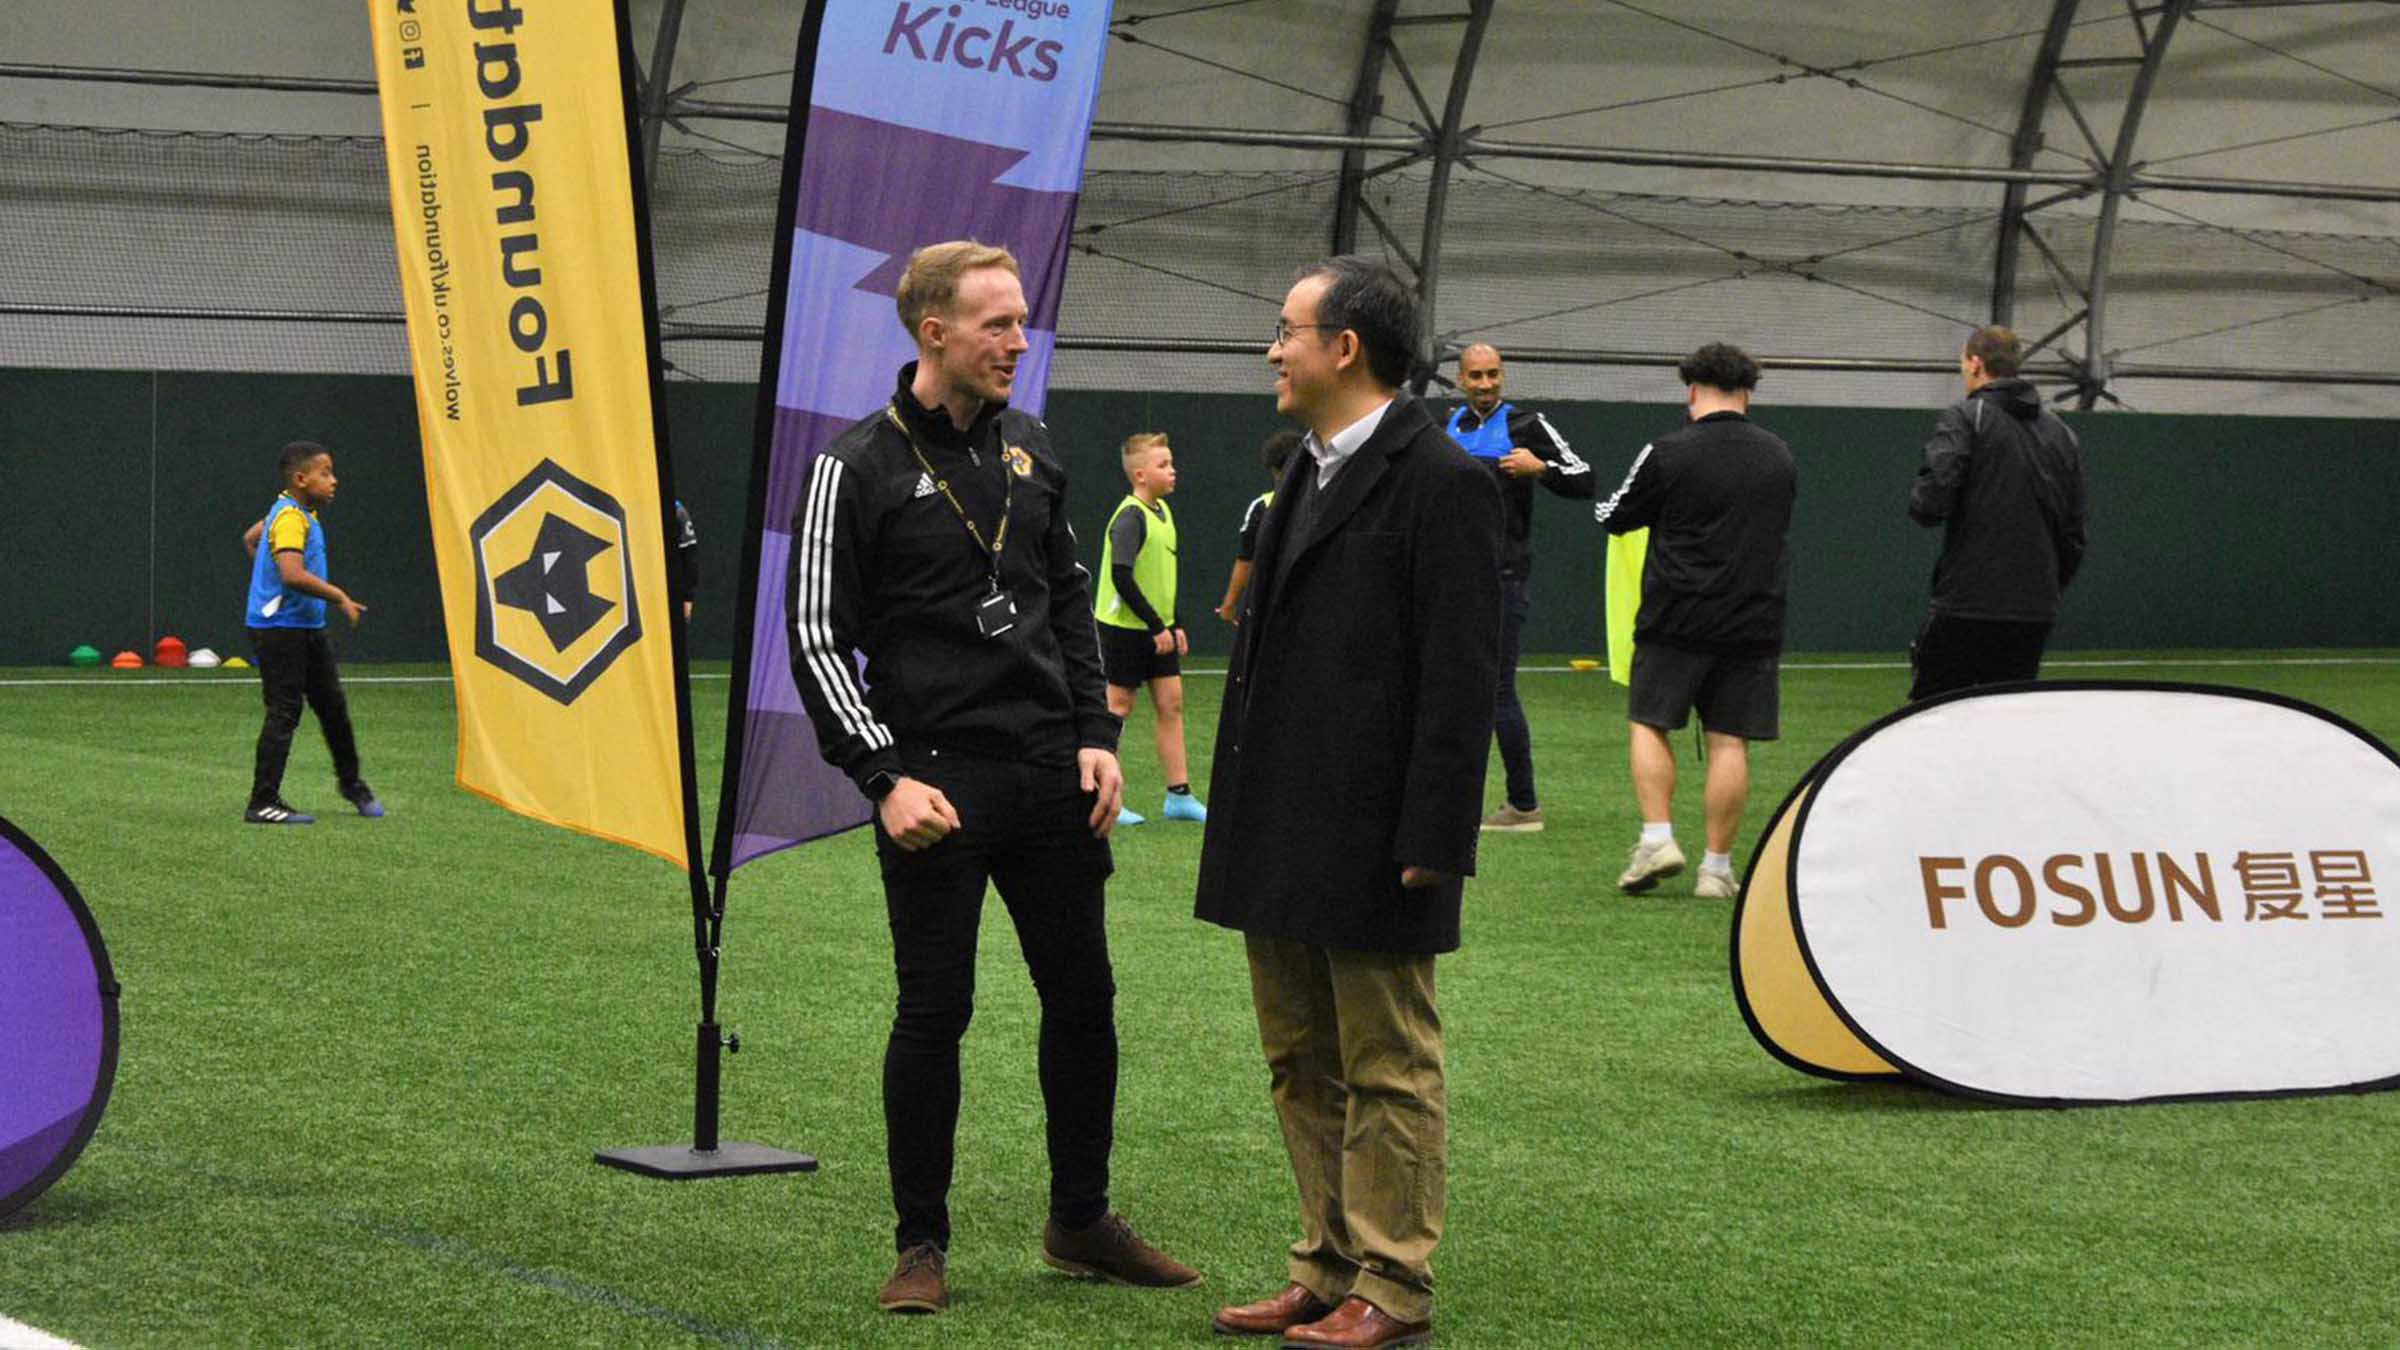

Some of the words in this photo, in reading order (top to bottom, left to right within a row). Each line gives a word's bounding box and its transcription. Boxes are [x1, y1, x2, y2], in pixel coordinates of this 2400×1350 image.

[883, 2, 1063, 81] Kicks
[985, 0, 1070, 19] eague
[1919, 852, 2223, 929] FOSUN
[2231, 849, 2384, 922] 复星
